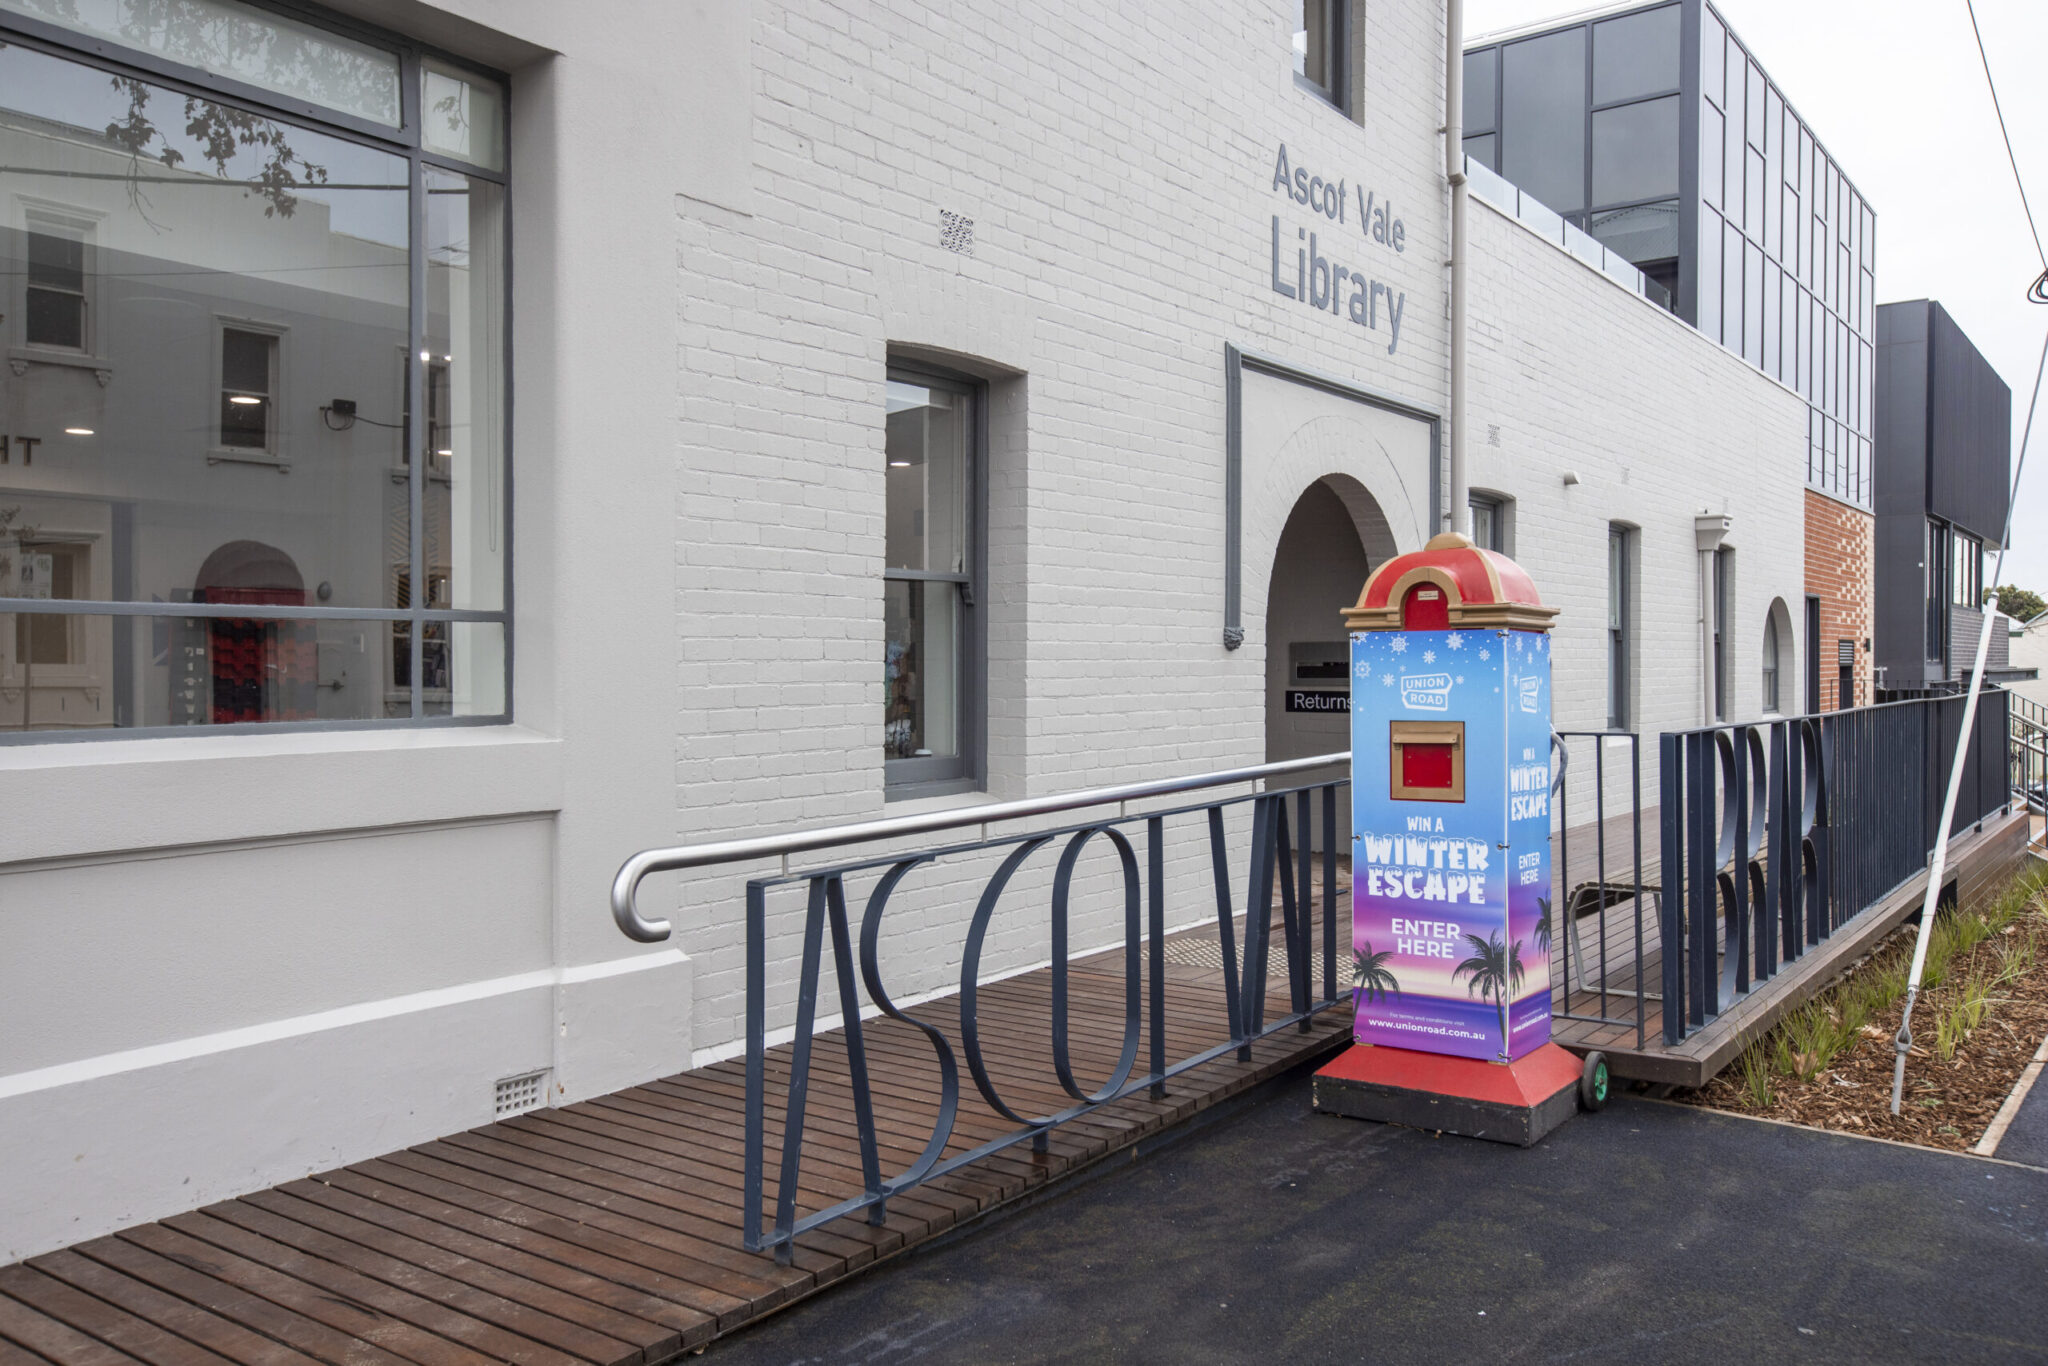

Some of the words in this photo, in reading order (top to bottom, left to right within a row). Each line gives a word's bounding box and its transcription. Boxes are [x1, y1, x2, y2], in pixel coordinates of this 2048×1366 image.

[1272, 143, 1347, 225] Ascot
[1356, 183, 1406, 253] Vale
[1271, 214, 1406, 355] Library
[1406, 677, 1446, 689] UNION
[1410, 693, 1444, 705] ROAD
[1510, 764, 1548, 792] WINTER
[1511, 792, 1548, 821] ESCAPE
[1407, 816, 1431, 832] WIN
[1435, 817, 1444, 833] A
[1364, 832, 1489, 871] WINTER
[1518, 852, 1540, 870] ENTER
[1368, 865, 1486, 904] ESCAPE
[1520, 868, 1539, 886] HERE
[1391, 918, 1460, 940] ENTER
[1397, 938, 1454, 959] HERE
[1368, 1018, 1486, 1040] www.unionroad.com.au
